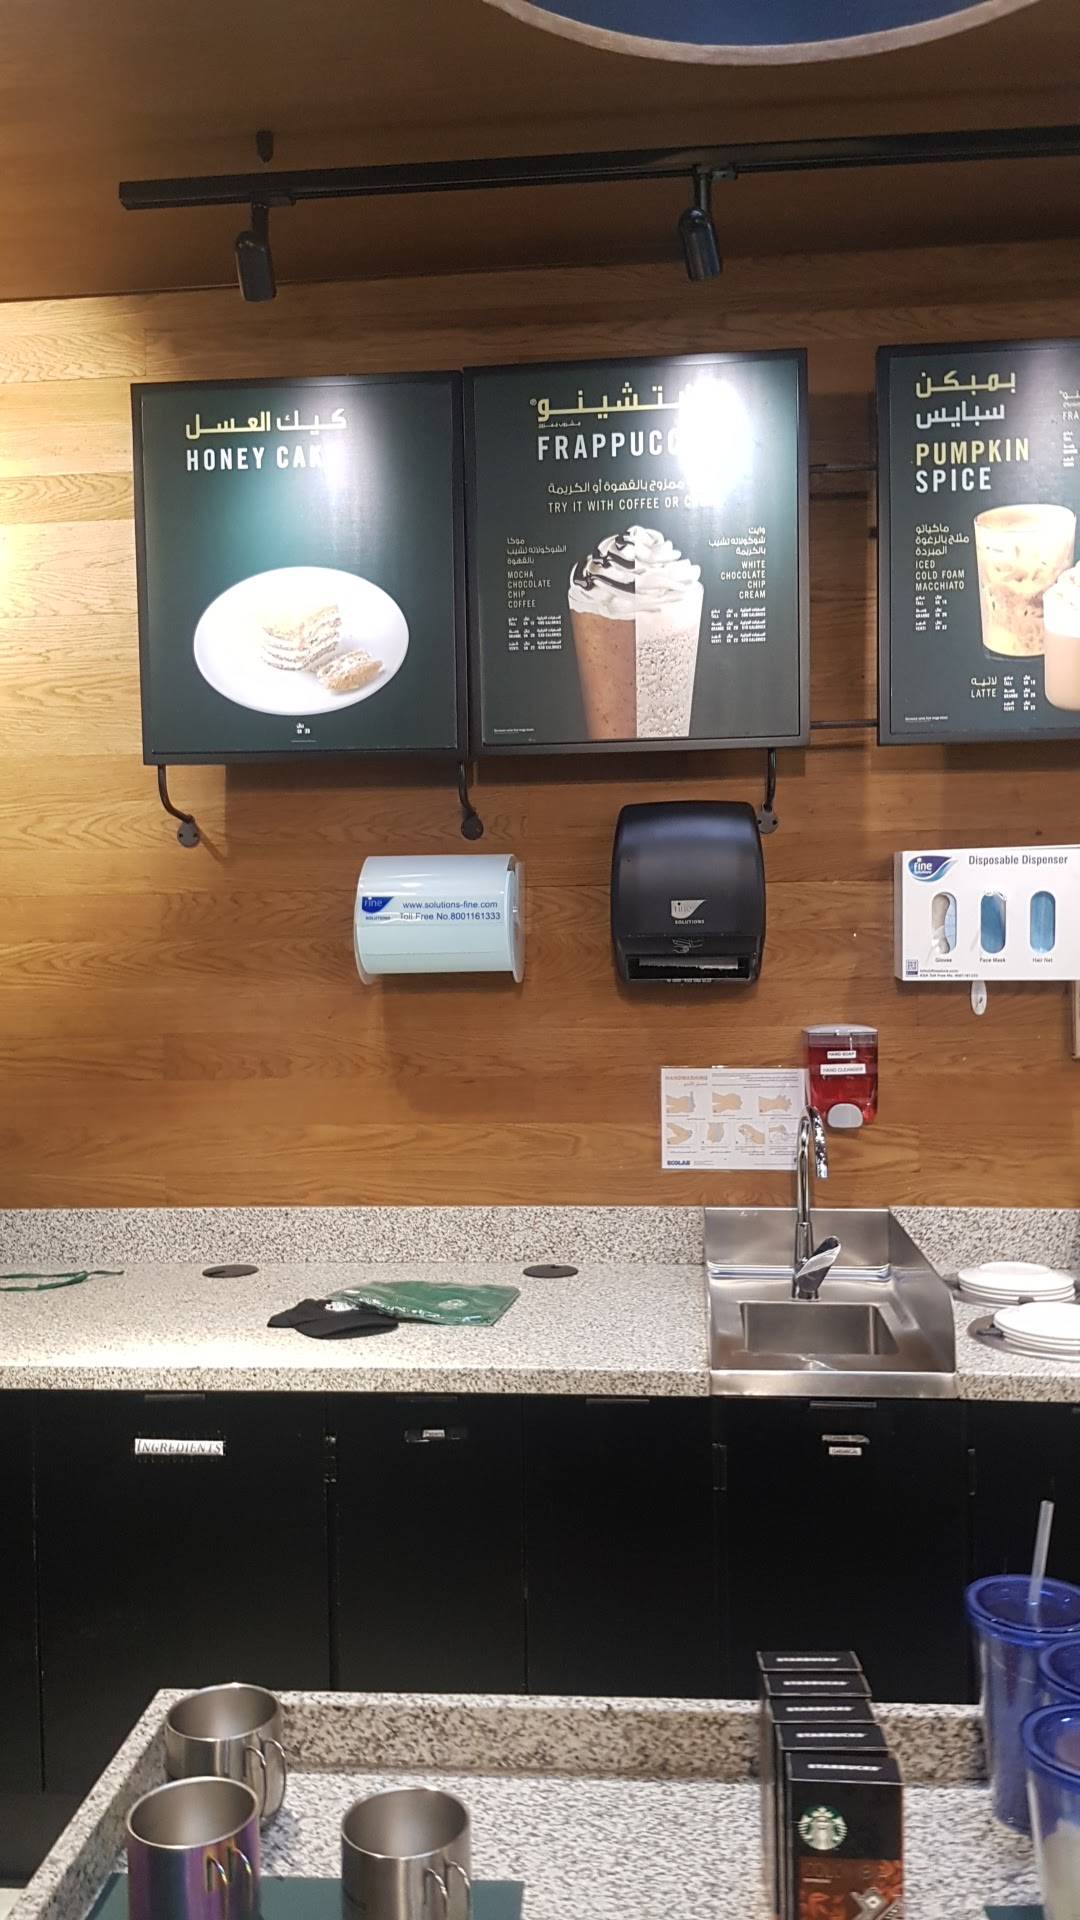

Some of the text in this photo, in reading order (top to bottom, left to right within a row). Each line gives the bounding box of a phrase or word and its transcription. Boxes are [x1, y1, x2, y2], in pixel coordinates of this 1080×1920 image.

[915, 370, 1017, 398] بمبكن
[916, 400, 1005, 429] سبايس
[186, 408, 347, 439] كيك العسل
[537, 430, 680, 460] FRAPPUCC
[916, 438, 1029, 466] PUMPKIN
[186, 445, 323, 471] HONEY CAK
[592, 478, 602, 493] أو
[915, 467, 992, 493] SPICE
[547, 480, 590, 495] الكريمة
[603, 479, 648, 493] بالقهوة
[548, 502, 568, 513] TRY
[573, 501, 582, 512] IT
[587, 500, 614, 511] WITH
[619, 498, 659, 510] COFFEE
[665, 496, 679, 507] OR
[741, 560, 765, 568] WHITE
[915, 560, 935, 569] ICED
[720, 570, 765, 580] CHOCOLATE
[915, 569, 965, 580] COLD FOAM
[507, 580, 551, 588] CHOCOLATE
[915, 581, 965, 591] MACCHIATO
[508, 590, 526, 599] CHIP
[739, 590, 765, 599] CREAM
[508, 600, 536, 608] COFFEE
[971, 688, 996, 698] LATTE
[968, 855, 1068, 867] Disposable Dispenser
[402, 901, 498, 909] www.solutions-fine.com
[415, 912, 434, 920] Free
